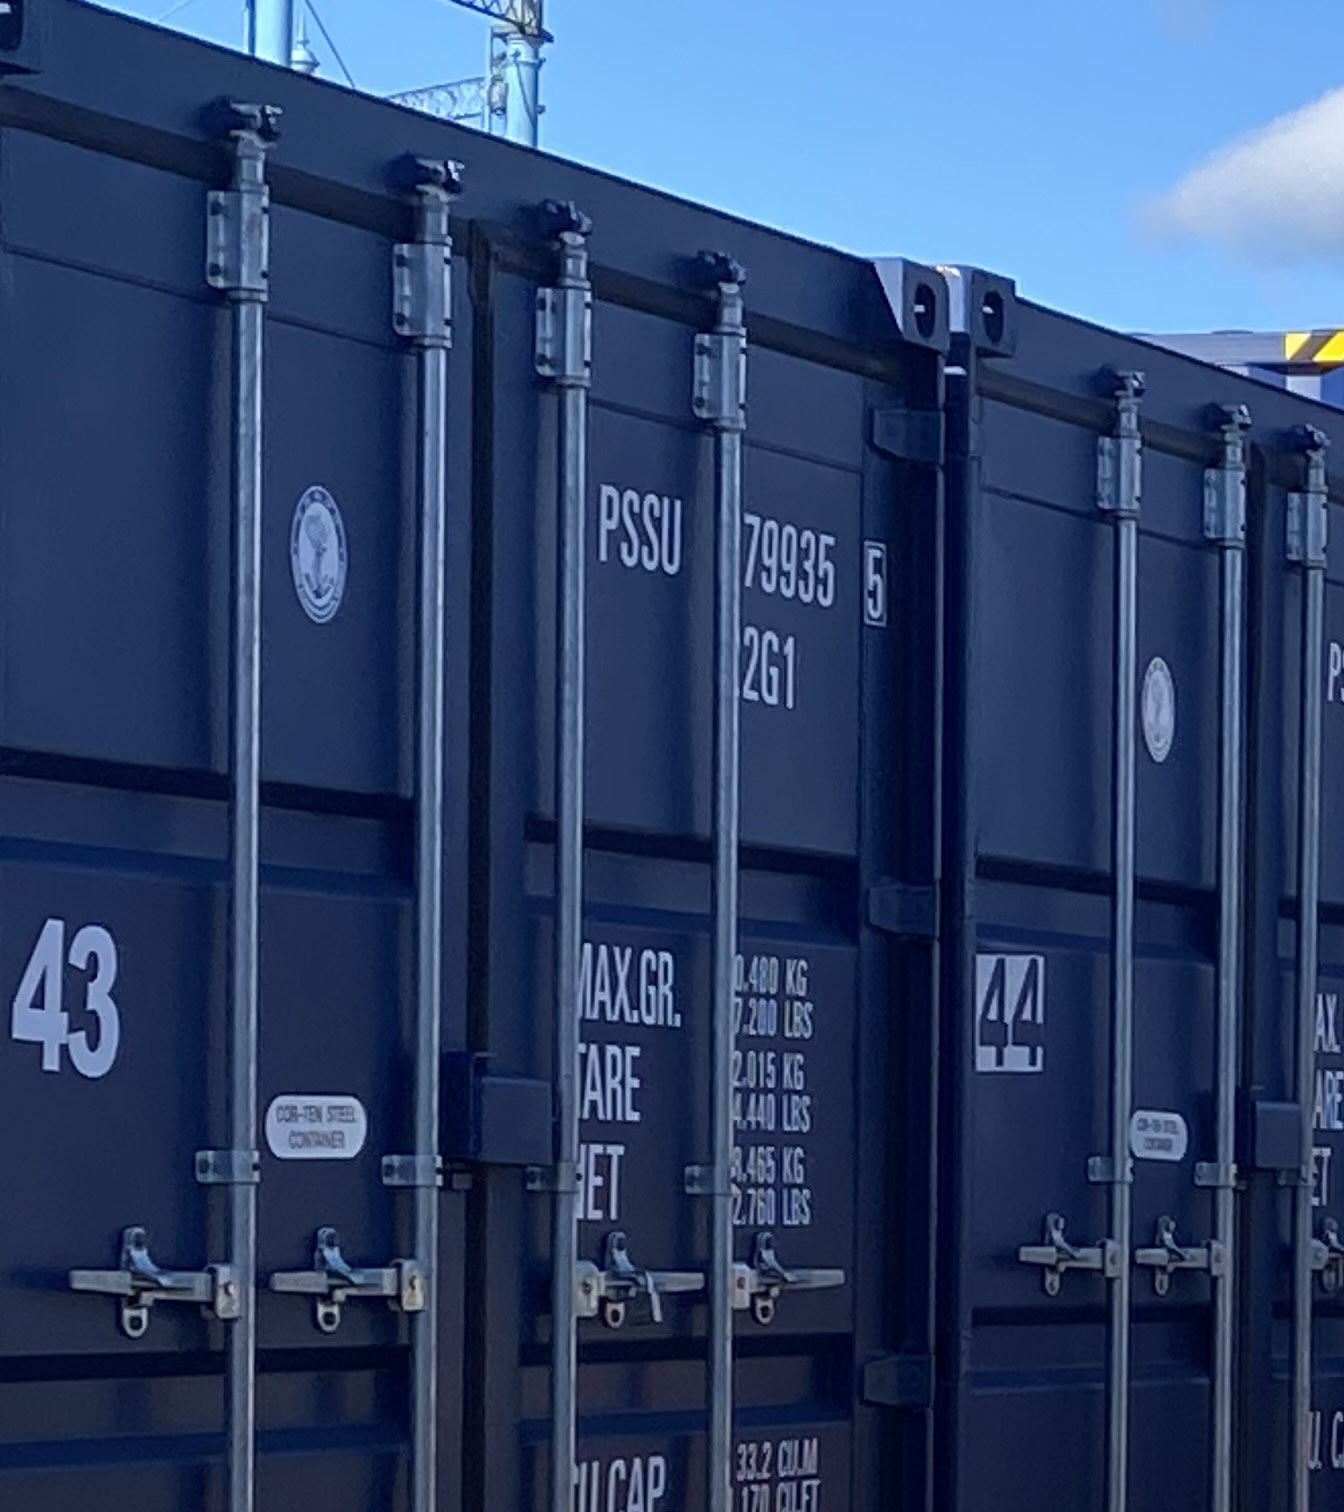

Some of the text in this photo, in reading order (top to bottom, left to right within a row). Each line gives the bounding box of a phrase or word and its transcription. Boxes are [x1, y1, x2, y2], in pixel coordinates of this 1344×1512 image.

[599, 484, 681, 575] PSSU
[866, 545, 885, 622] 5
[742, 626, 795, 709] 2G1
[11, 917, 119, 1078] 43
[977, 956, 1043, 1069] 44
[577, 1044, 640, 1122] ARE
[1313, 1069, 1344, 1130] ARE
